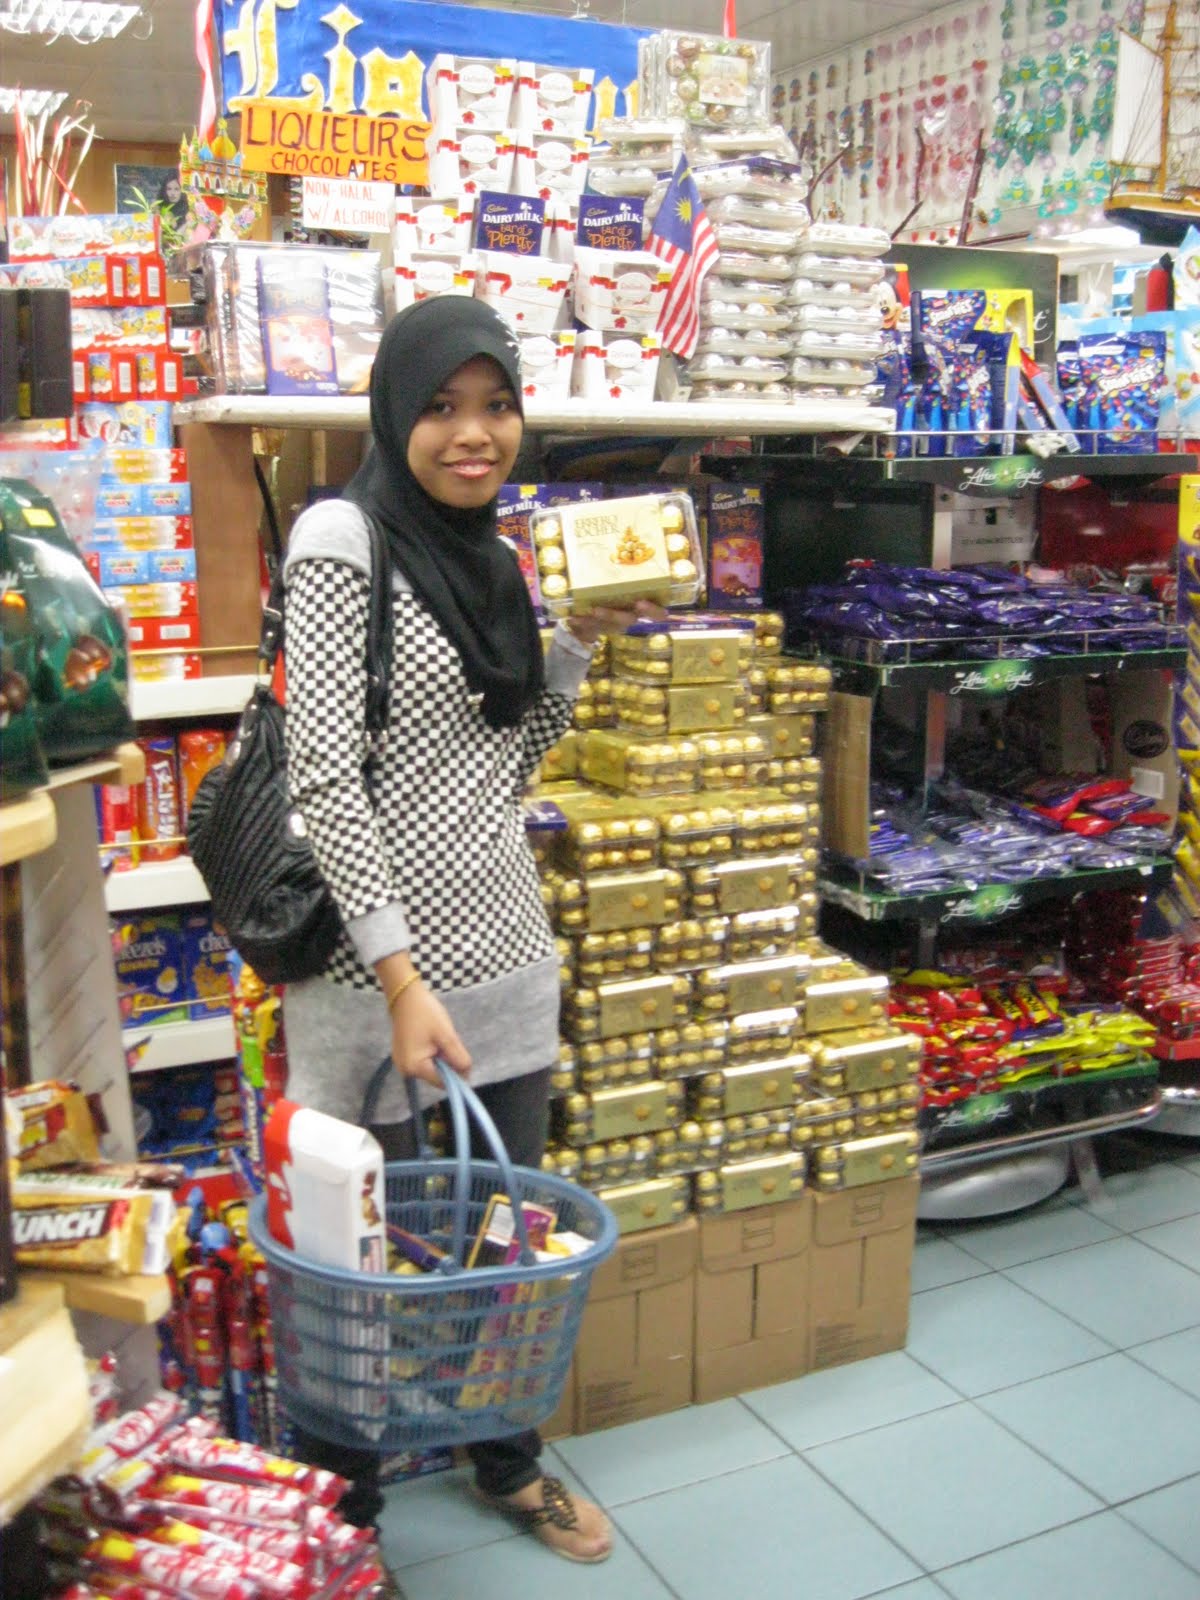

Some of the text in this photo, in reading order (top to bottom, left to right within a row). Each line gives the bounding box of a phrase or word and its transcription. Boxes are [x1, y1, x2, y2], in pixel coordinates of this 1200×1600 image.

[246, 106, 431, 162] LIQUEURS
[271, 150, 397, 181] CHOCOLATES
[482, 212, 513, 224] DAIRY
[583, 215, 614, 227] DAIRY
[487, 229, 536, 253] Plenty
[588, 232, 636, 251] Plenty
[958, 466, 1000, 491] After
[13, 1206, 107, 1245] UNCH
